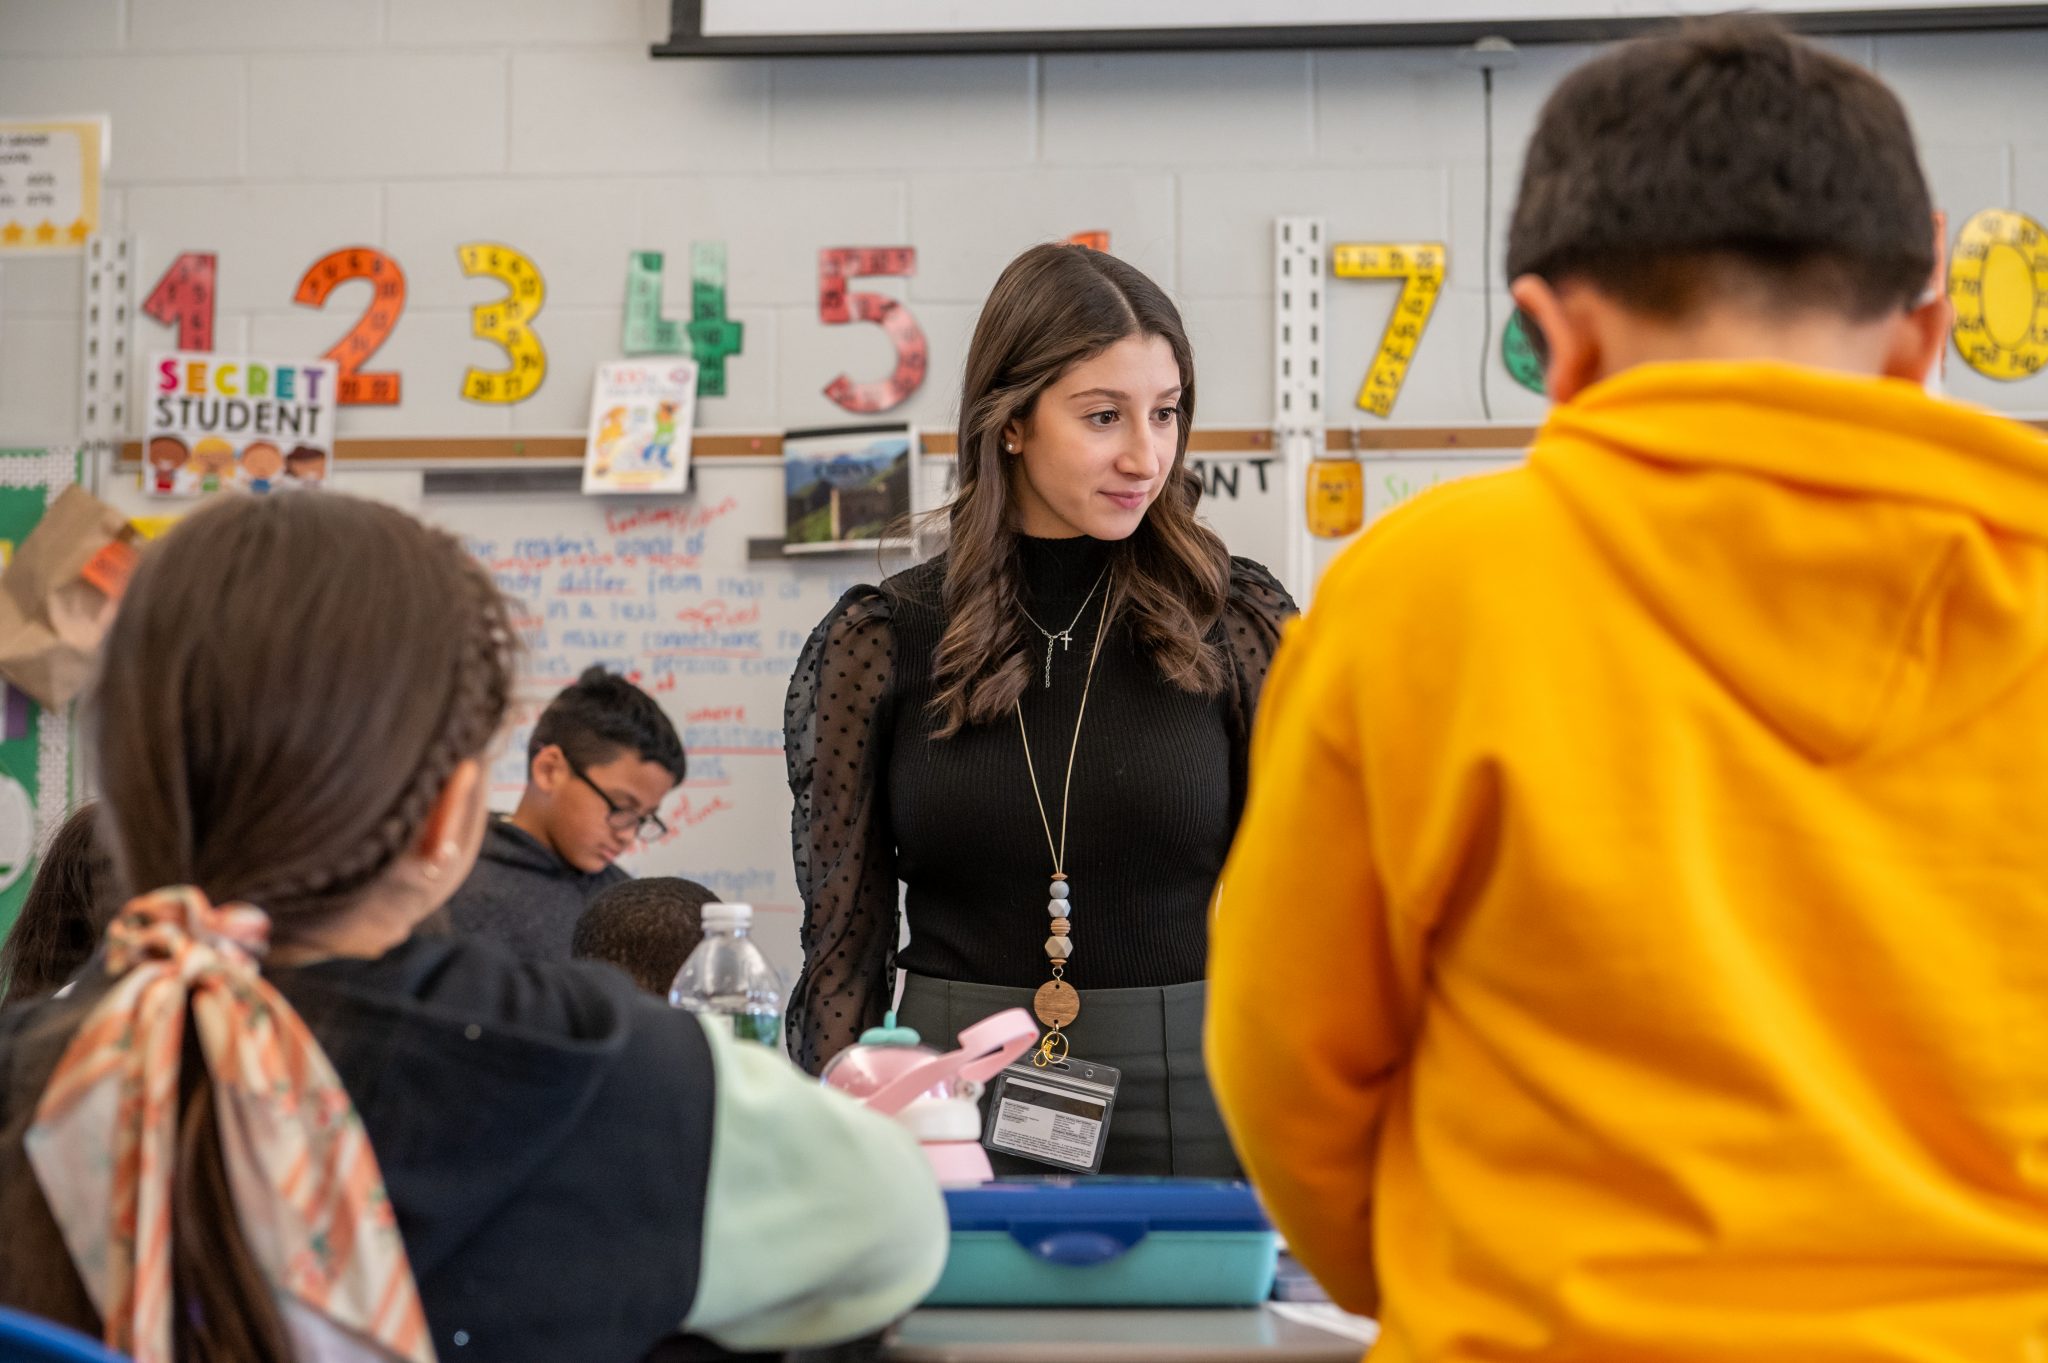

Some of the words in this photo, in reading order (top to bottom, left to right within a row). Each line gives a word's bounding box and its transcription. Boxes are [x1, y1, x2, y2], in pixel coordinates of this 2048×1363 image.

[293, 247, 407, 406] 2
[456, 241, 547, 406] 3
[621, 240, 743, 397] 4
[818, 246, 928, 415] 5
[1331, 243, 1448, 418] 7
[159, 359, 325, 400] SECRET
[155, 396, 325, 435] STUDENT
